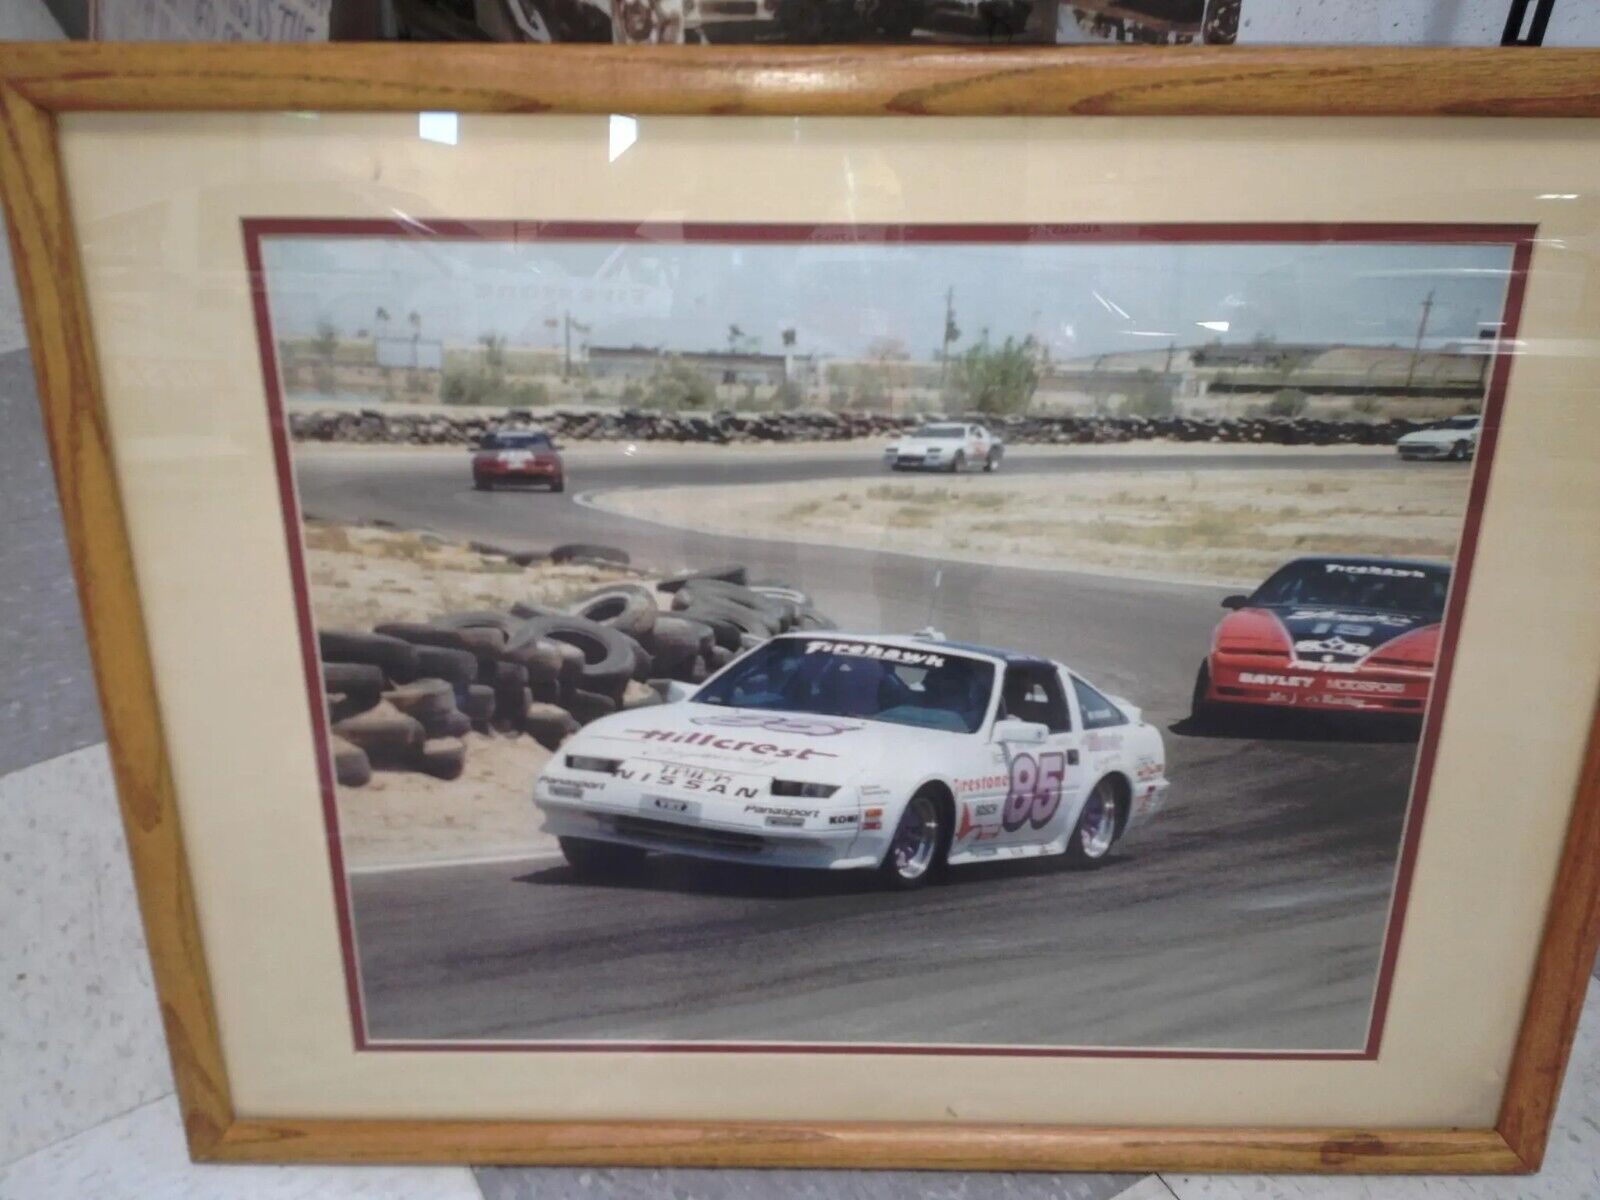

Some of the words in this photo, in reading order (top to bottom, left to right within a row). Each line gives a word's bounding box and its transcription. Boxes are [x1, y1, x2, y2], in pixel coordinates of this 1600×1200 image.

[624, 729, 839, 760] Hillcrest
[611, 767, 760, 799] NISSAN
[1002, 752, 1065, 833] 85
[744, 805, 821, 818] Panasport
